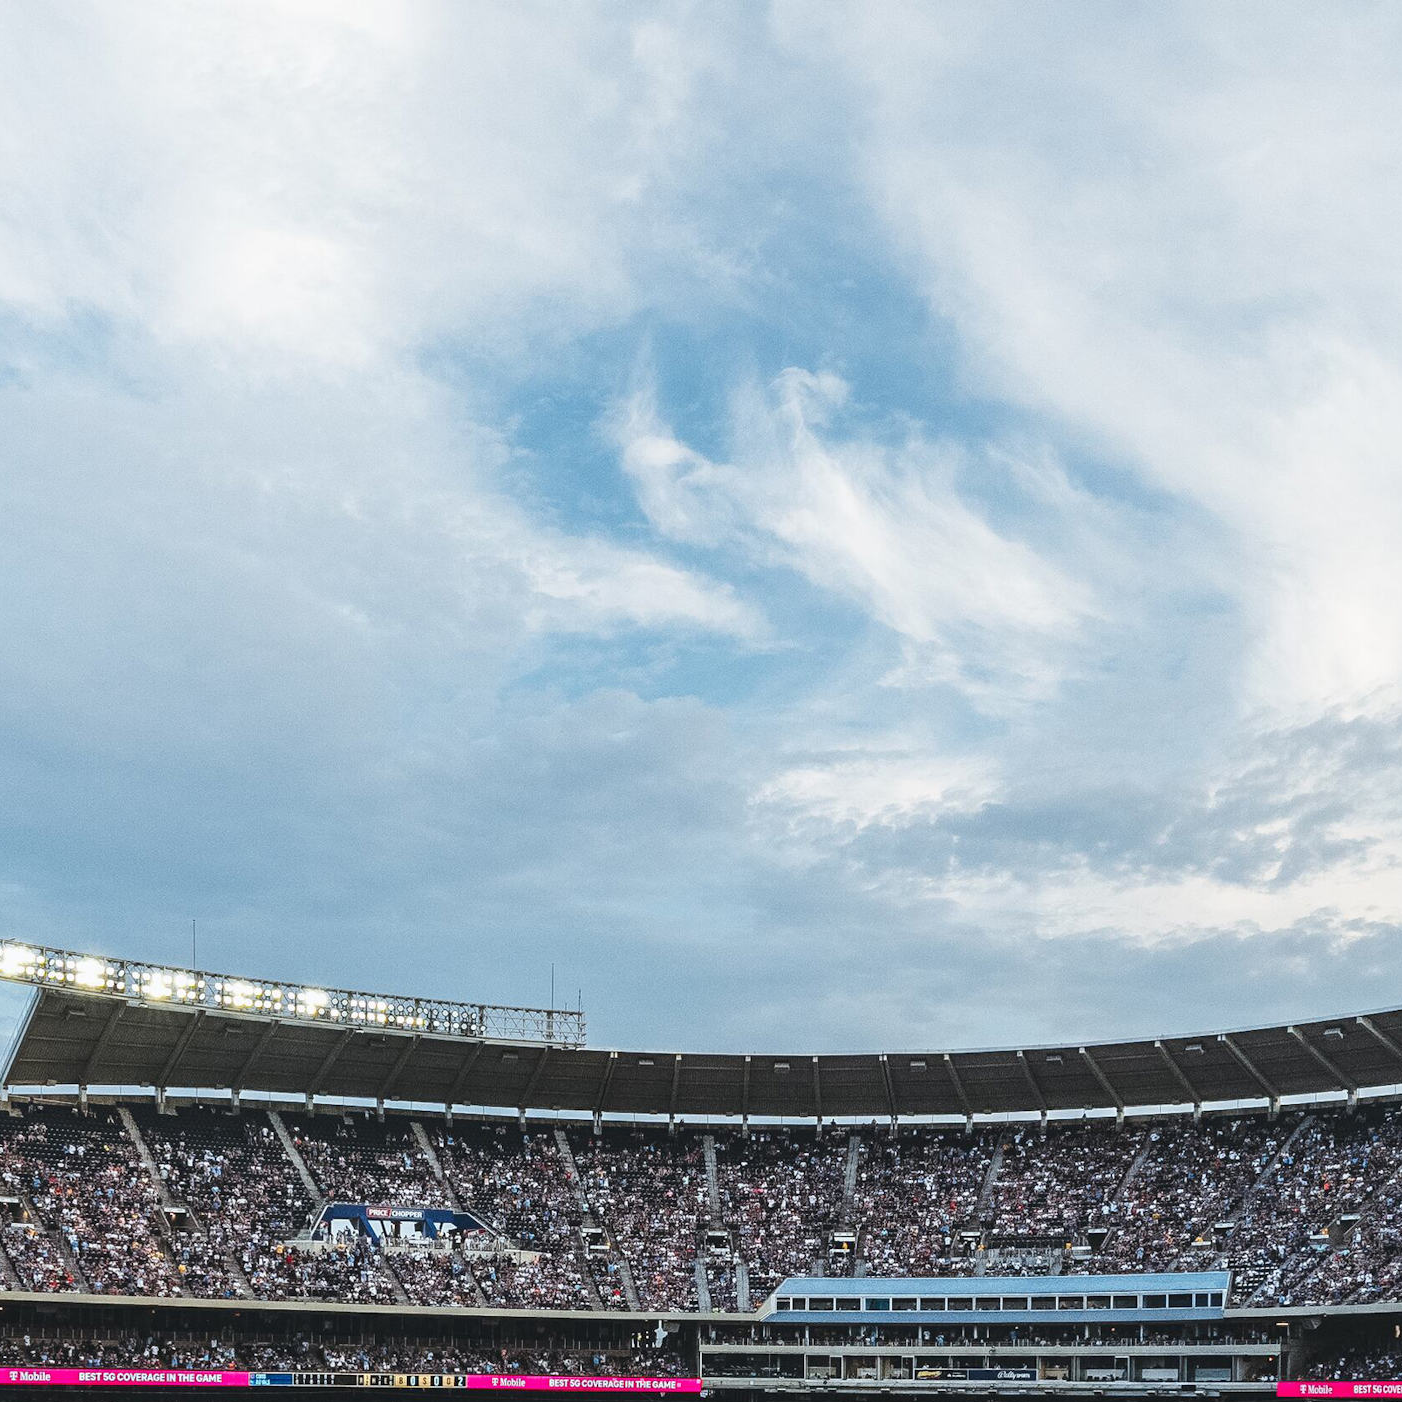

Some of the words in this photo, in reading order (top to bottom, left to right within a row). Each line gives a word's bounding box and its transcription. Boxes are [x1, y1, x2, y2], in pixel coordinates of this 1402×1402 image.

[392, 1210, 422, 1218] CHOPPER
[20, 1371, 51, 1382] Mobile
[78, 1373, 102, 1382] BEST
[103, 1373, 116, 1382] 5G
[117, 1373, 164, 1383] COVERAGE
[166, 1374, 177, 1383] IN
[178, 1374, 195, 1384] THE
[196, 1374, 223, 1384] GAME
[457, 1377, 464, 1386] 2
[500, 1378, 526, 1387] Mobile
[549, 1378, 569, 1387] BEST
[570, 1379, 581, 1387] 5G
[582, 1379, 624, 1388] COVERAGE
[625, 1380, 634, 1388] IN
[635, 1380, 649, 1388] THE
[652, 1381, 676, 1389] GAME
[1308, 1385, 1333, 1395] Mobile
[1353, 1385, 1372, 1394] BEST
[1372, 1385, 1382, 1394] 5G
